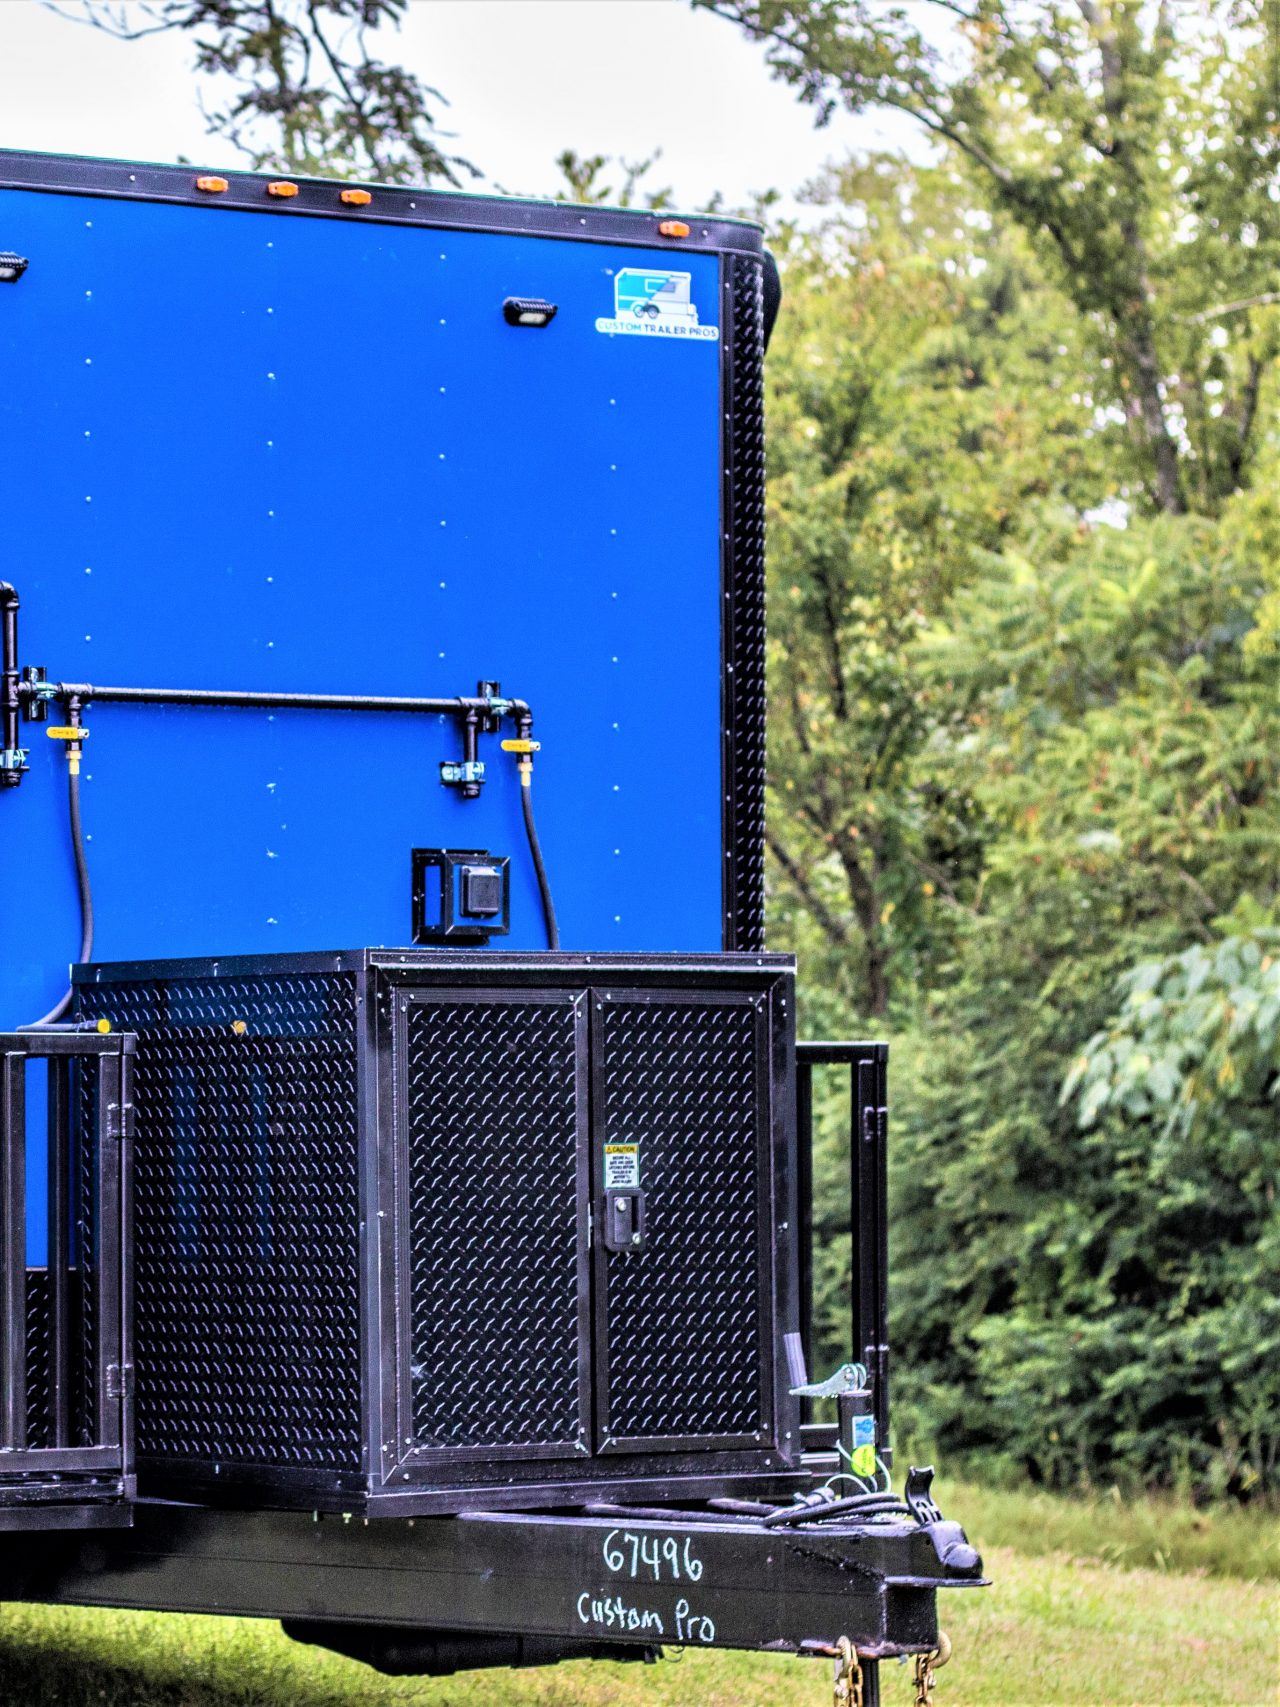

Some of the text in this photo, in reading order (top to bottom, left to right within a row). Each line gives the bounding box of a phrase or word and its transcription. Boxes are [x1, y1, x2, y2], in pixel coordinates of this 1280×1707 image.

[597, 320, 717, 338] CUSTOM TRAILER PROS
[602, 1529, 704, 1582] 67496
[576, 1592, 716, 1642] Custom Pro
